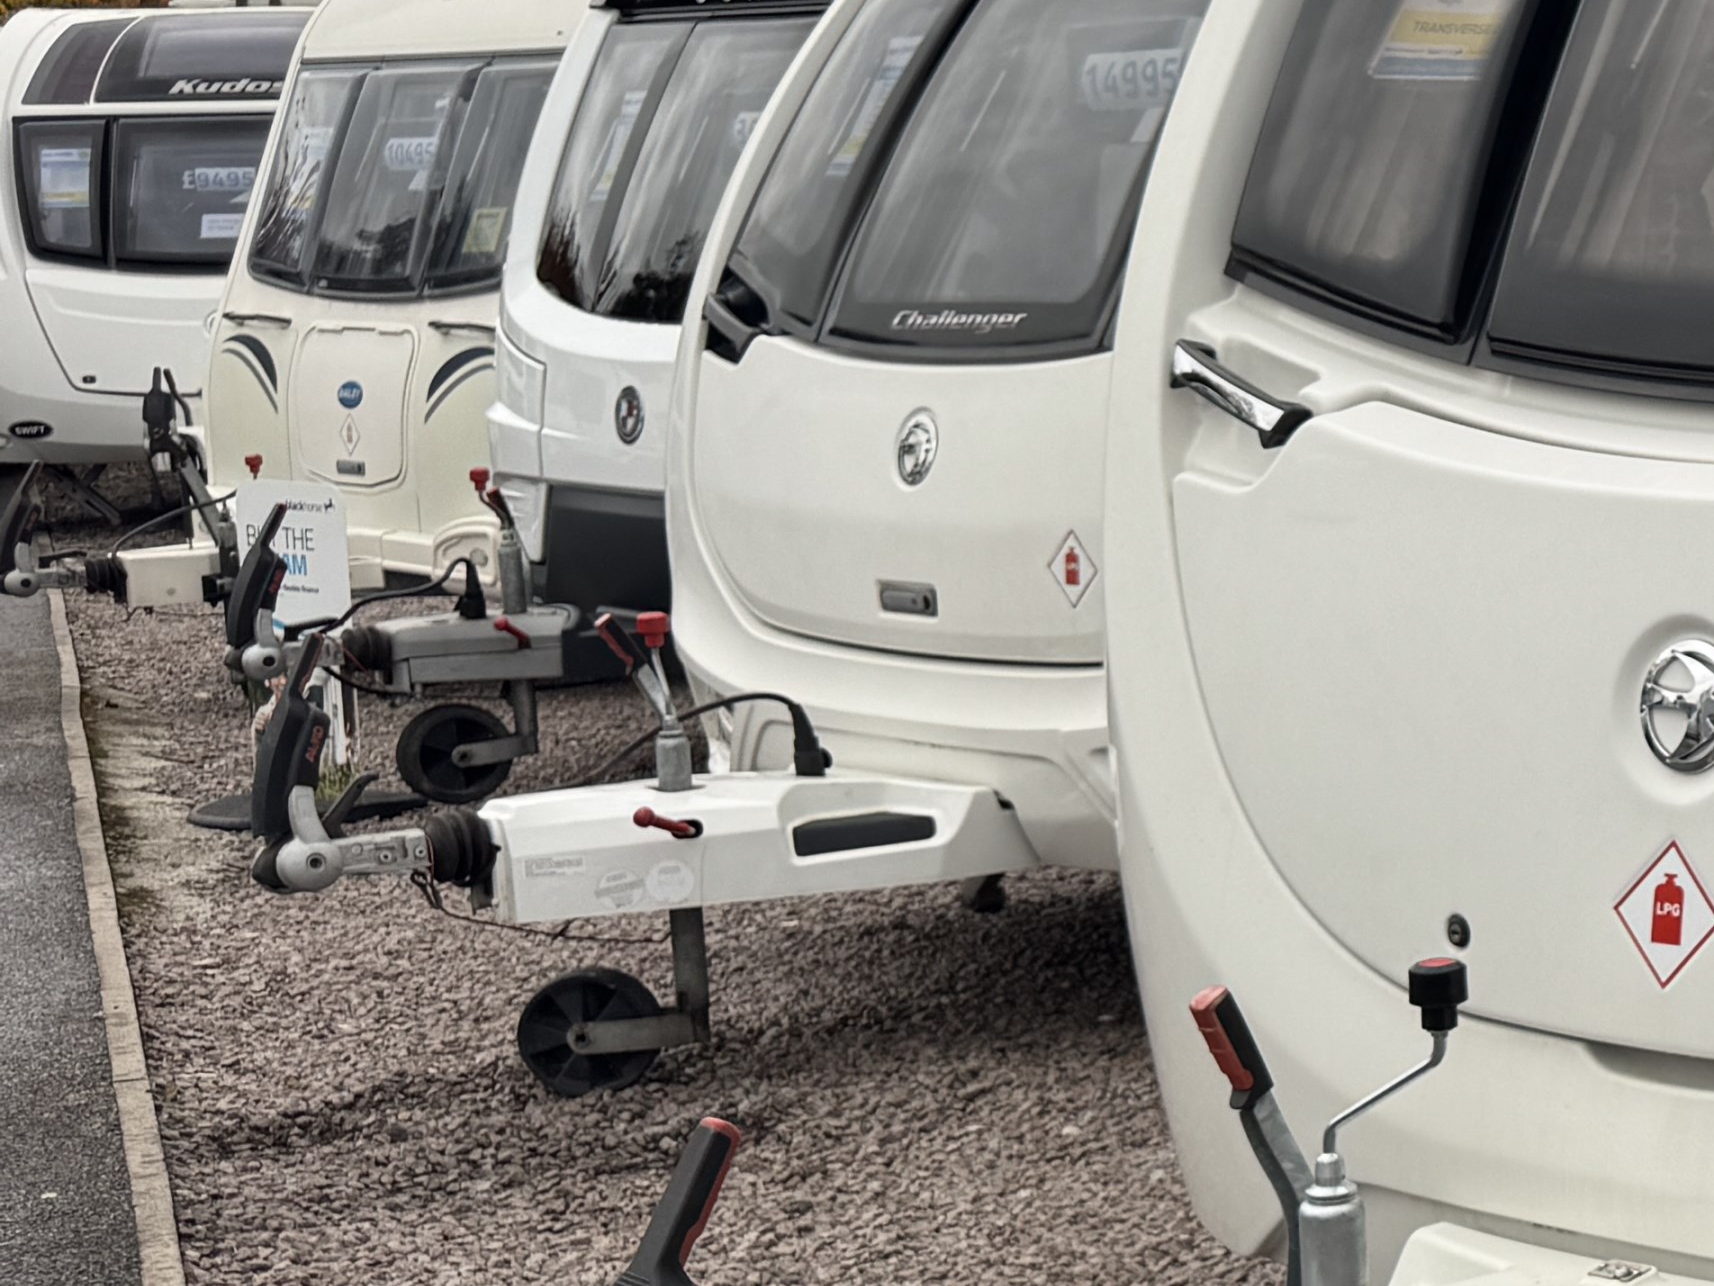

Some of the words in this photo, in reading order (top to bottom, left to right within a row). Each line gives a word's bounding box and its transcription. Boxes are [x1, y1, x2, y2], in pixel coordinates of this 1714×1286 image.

[890, 310, 1028, 335] Challenger
[281, 526, 316, 552] THE
[1656, 901, 1681, 917] LPG
